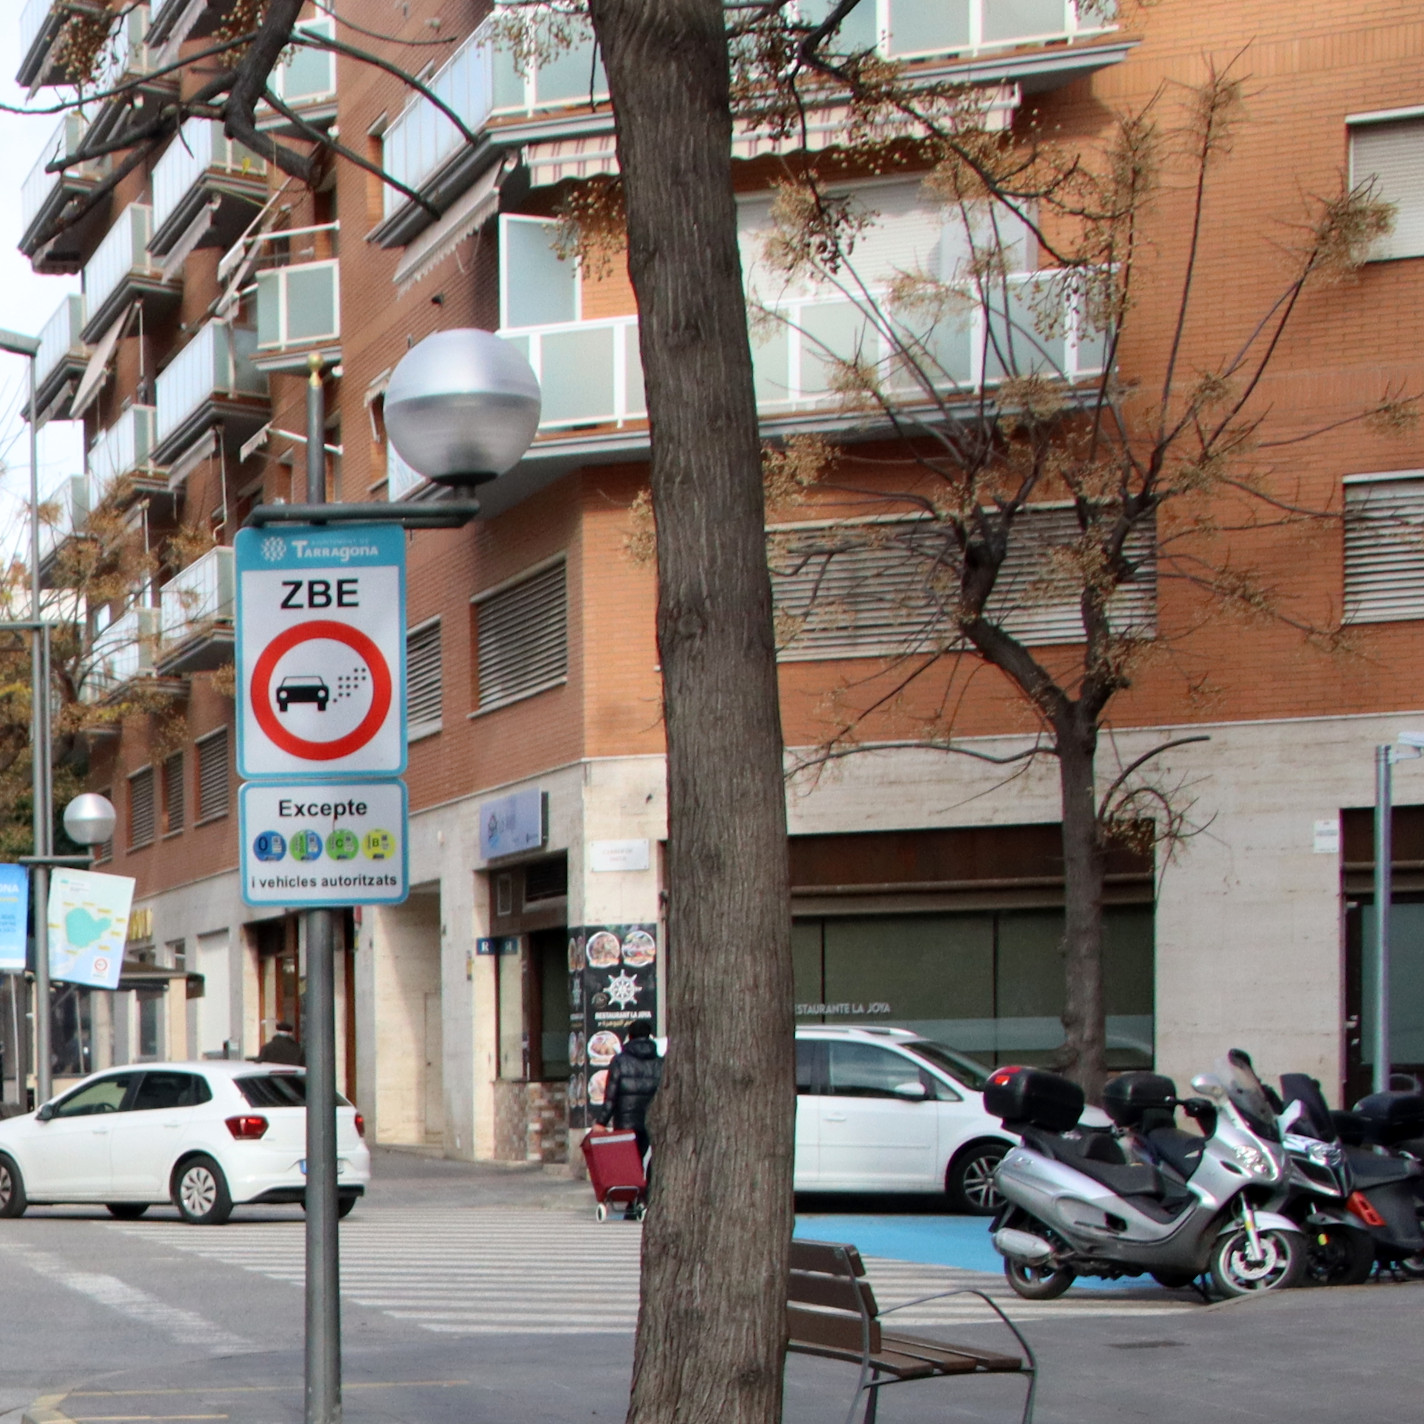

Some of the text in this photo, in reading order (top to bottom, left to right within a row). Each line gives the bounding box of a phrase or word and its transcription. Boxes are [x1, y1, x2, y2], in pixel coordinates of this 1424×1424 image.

[280, 578, 360, 610] ZBE
[279, 798, 368, 821] Excepte
[372, 837, 380, 848] B
[251, 873, 397, 889] i vehicles autoritzats
[795, 1002, 891, 1015] STAURANTE LA JOYA
